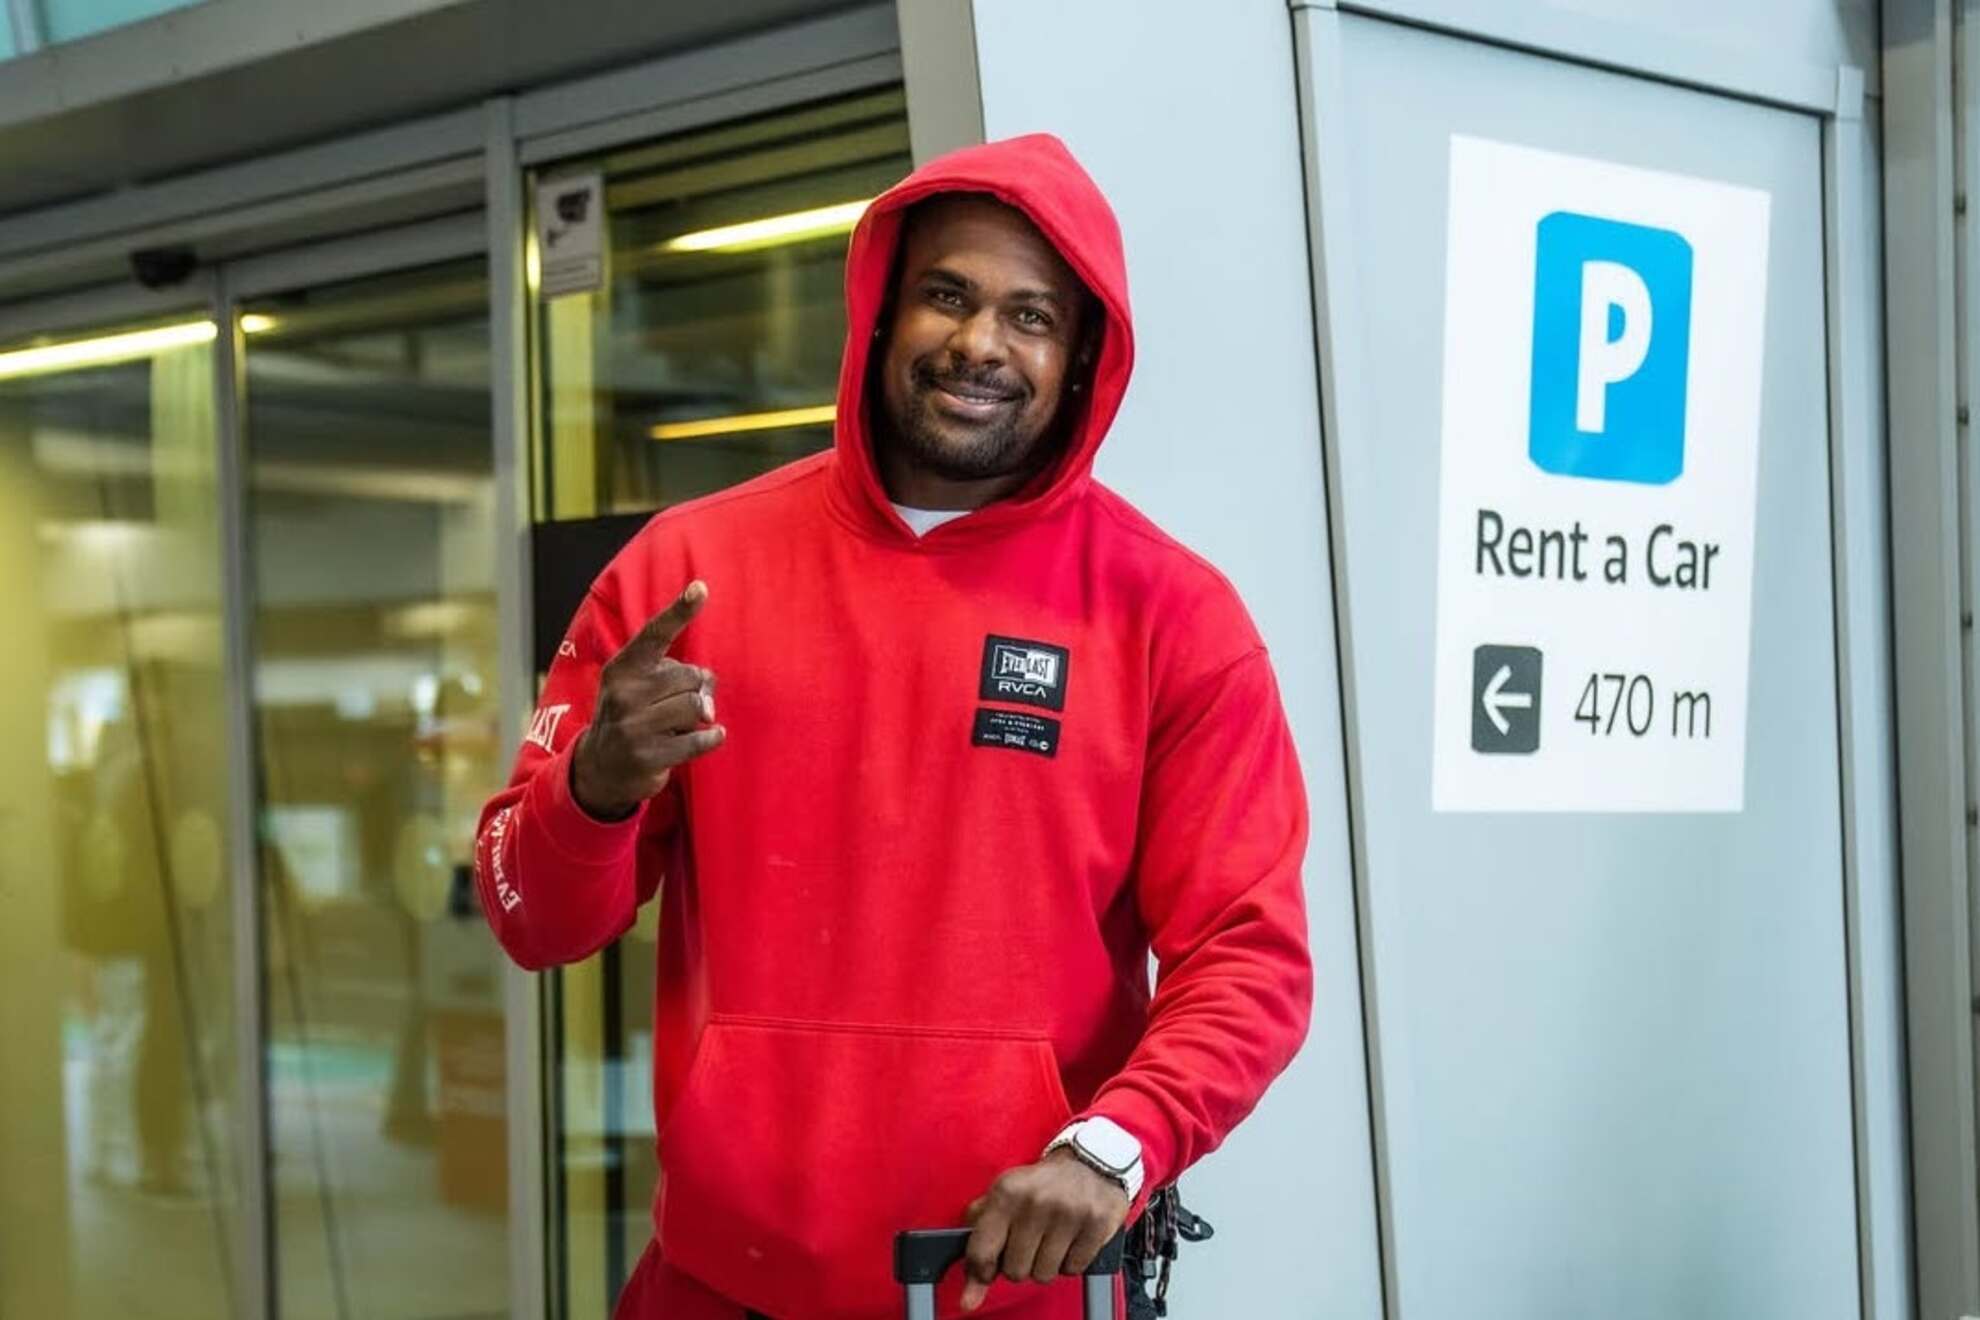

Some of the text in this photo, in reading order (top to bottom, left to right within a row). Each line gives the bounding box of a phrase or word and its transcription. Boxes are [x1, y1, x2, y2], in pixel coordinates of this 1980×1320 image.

[1576, 259, 1653, 434] P
[1475, 508, 1719, 590] Rent a Car
[998, 680, 1047, 699] RVCA
[1574, 672, 1711, 738] 470 m
